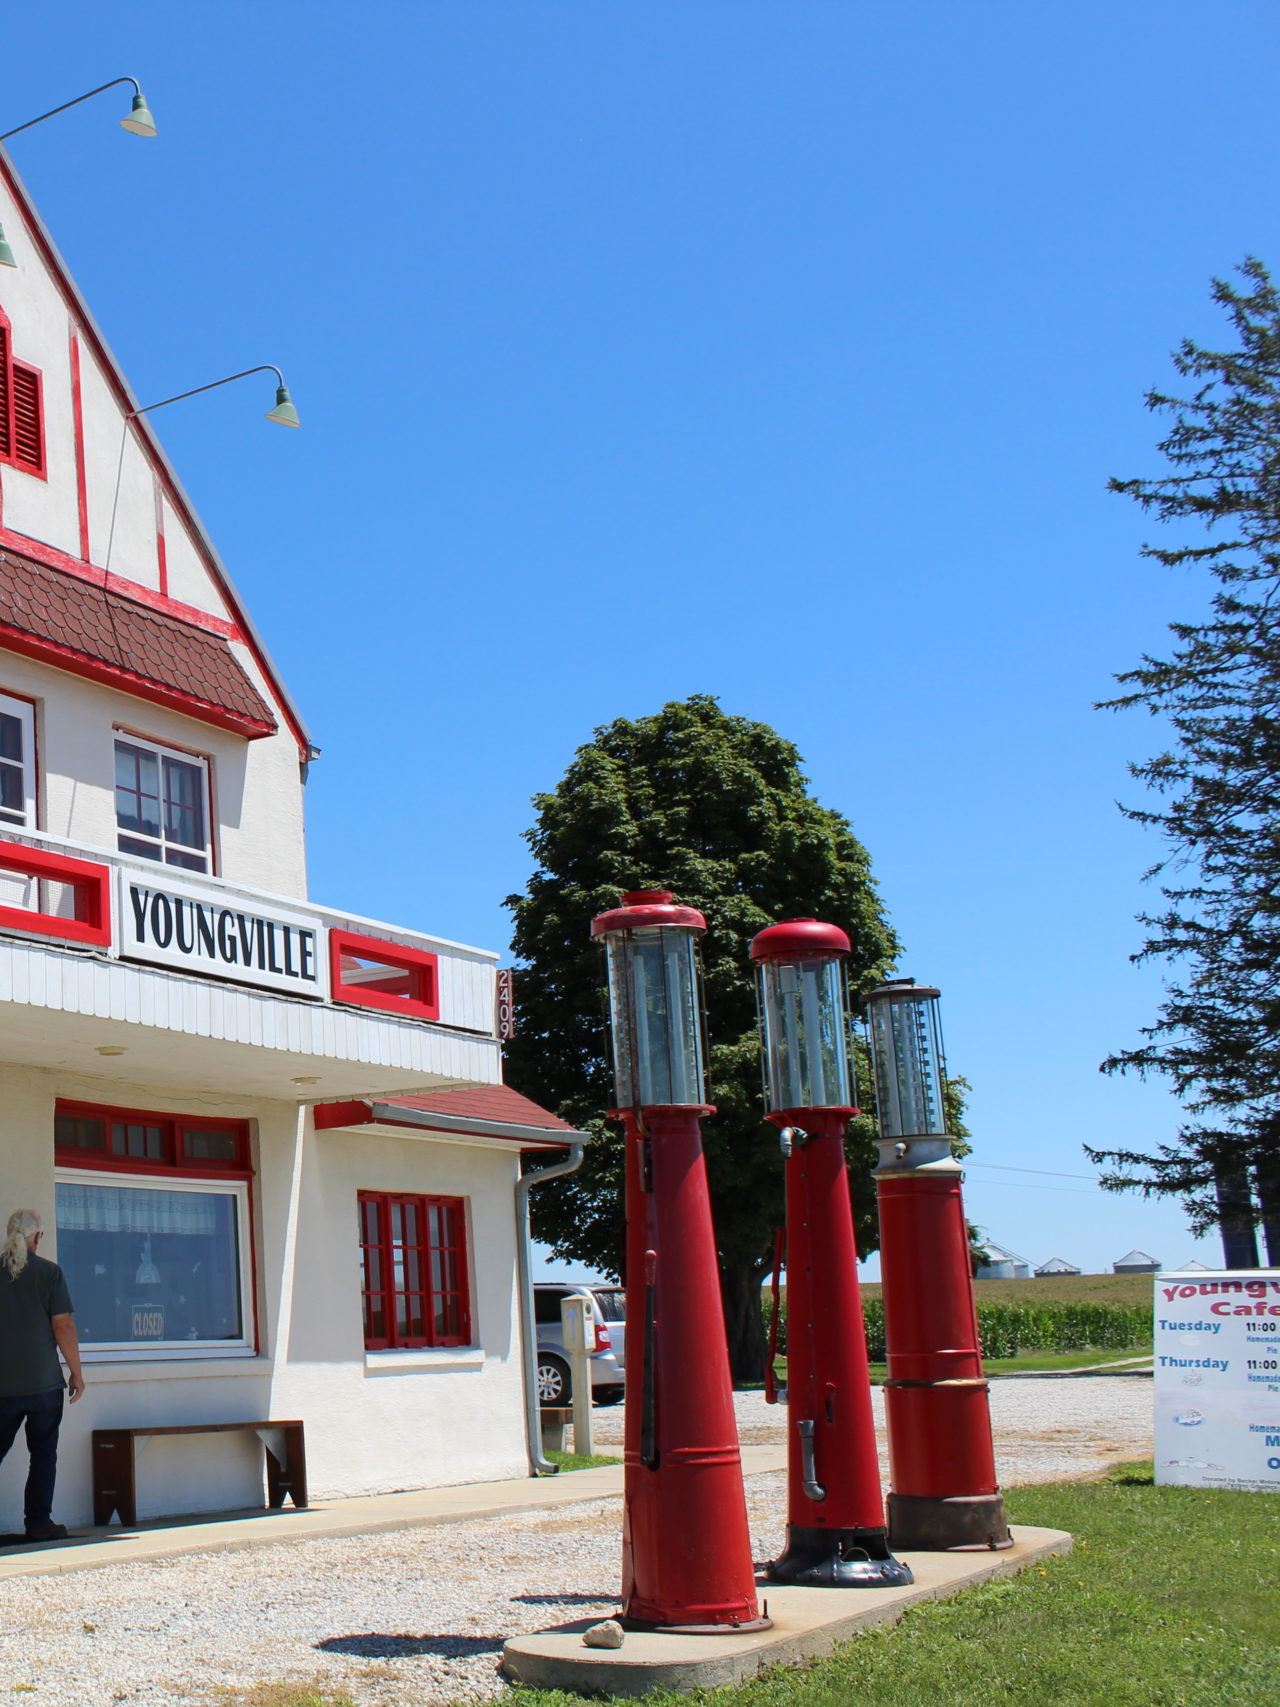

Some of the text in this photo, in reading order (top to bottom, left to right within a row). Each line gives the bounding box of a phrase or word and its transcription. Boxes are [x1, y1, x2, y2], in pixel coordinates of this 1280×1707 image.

[130, 886, 316, 982] YOUNGVILLE
[499, 970, 510, 1039] 2409
[1210, 1302, 1280, 1316] Cafe
[133, 1312, 163, 1337] CLOSED
[1159, 1320, 1276, 1334] Tuesday 11:00
[1159, 1356, 1277, 1371] Thursday 11:00
